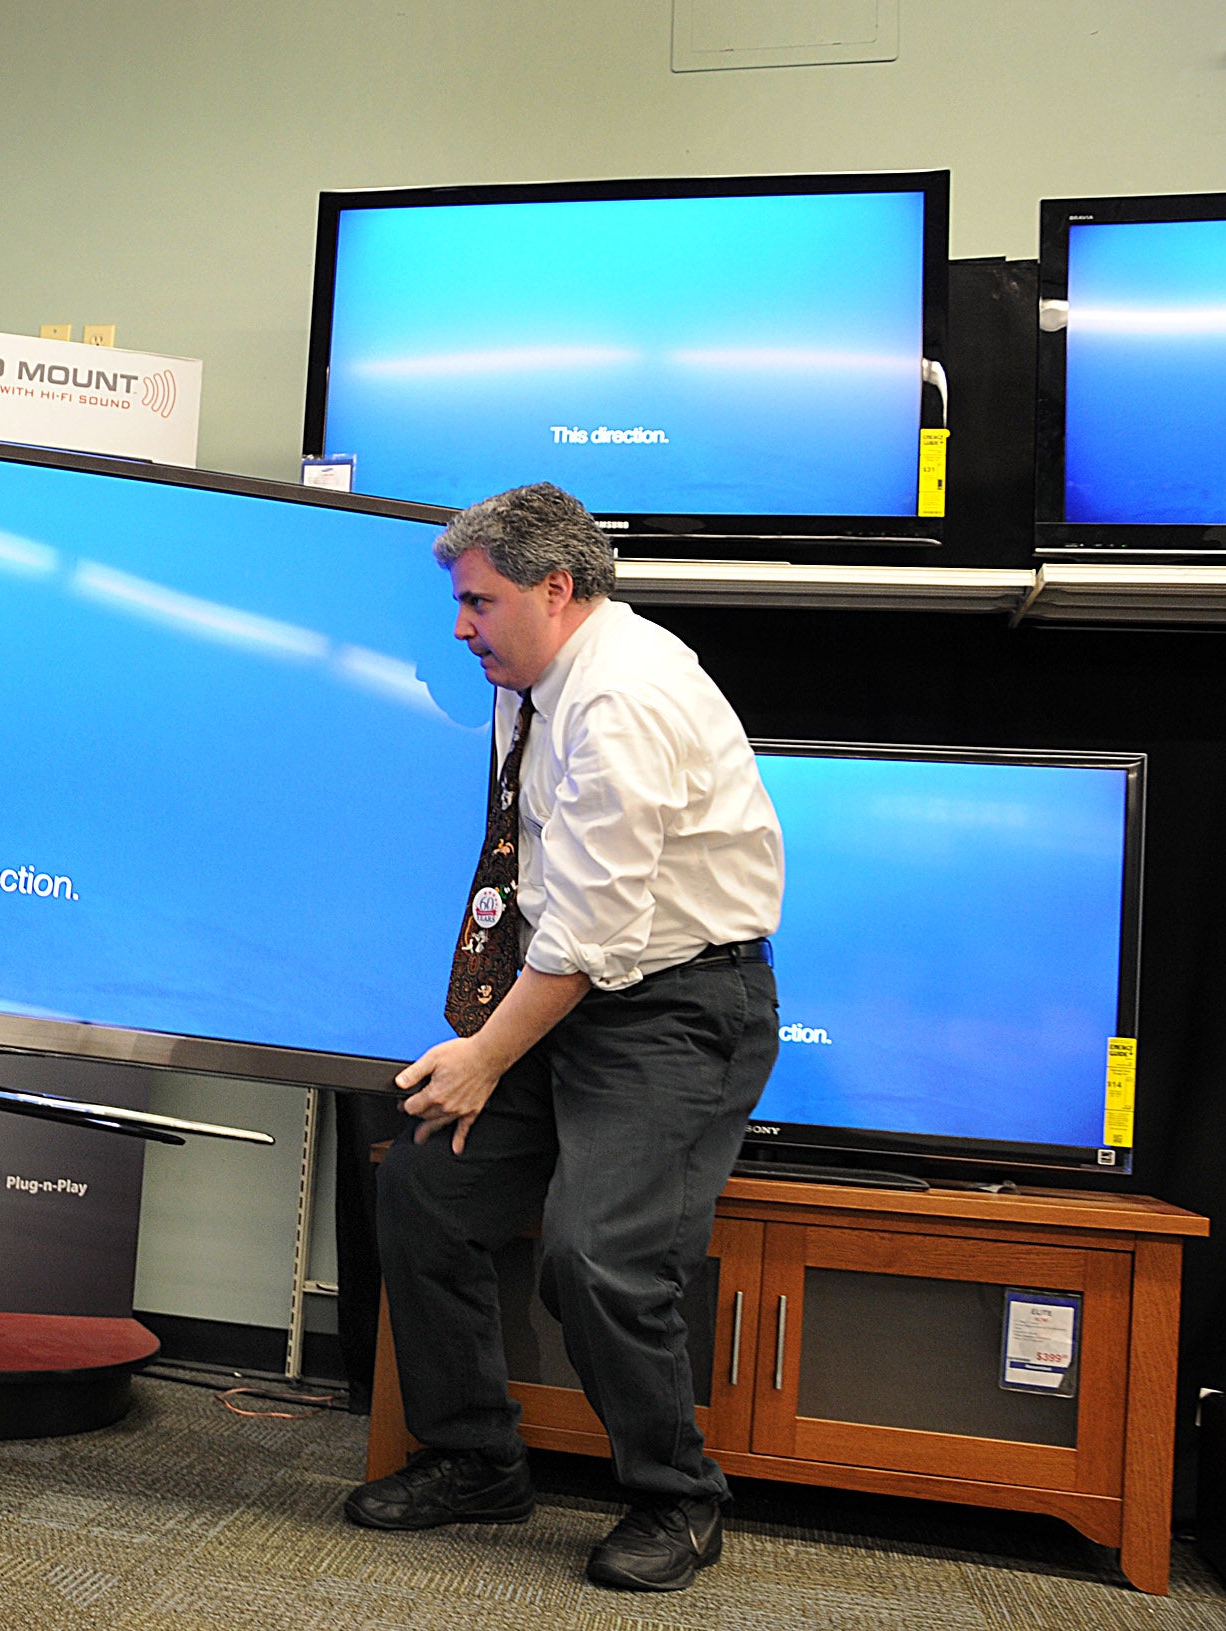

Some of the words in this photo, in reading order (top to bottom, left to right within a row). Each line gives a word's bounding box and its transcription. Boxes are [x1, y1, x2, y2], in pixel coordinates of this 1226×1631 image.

[17, 360, 139, 394] MOUNT
[0, 385, 35, 398] WITH
[40, 389, 72, 402] HI-FI
[79, 394, 131, 409] SOUND
[550, 426, 588, 444] This
[590, 426, 669, 444] direction.
[480, 897, 494, 911] 60
[778, 1023, 832, 1044] ction.
[744, 1125, 781, 1135] SONY
[6, 1175, 88, 1197] Plug-n-Play
